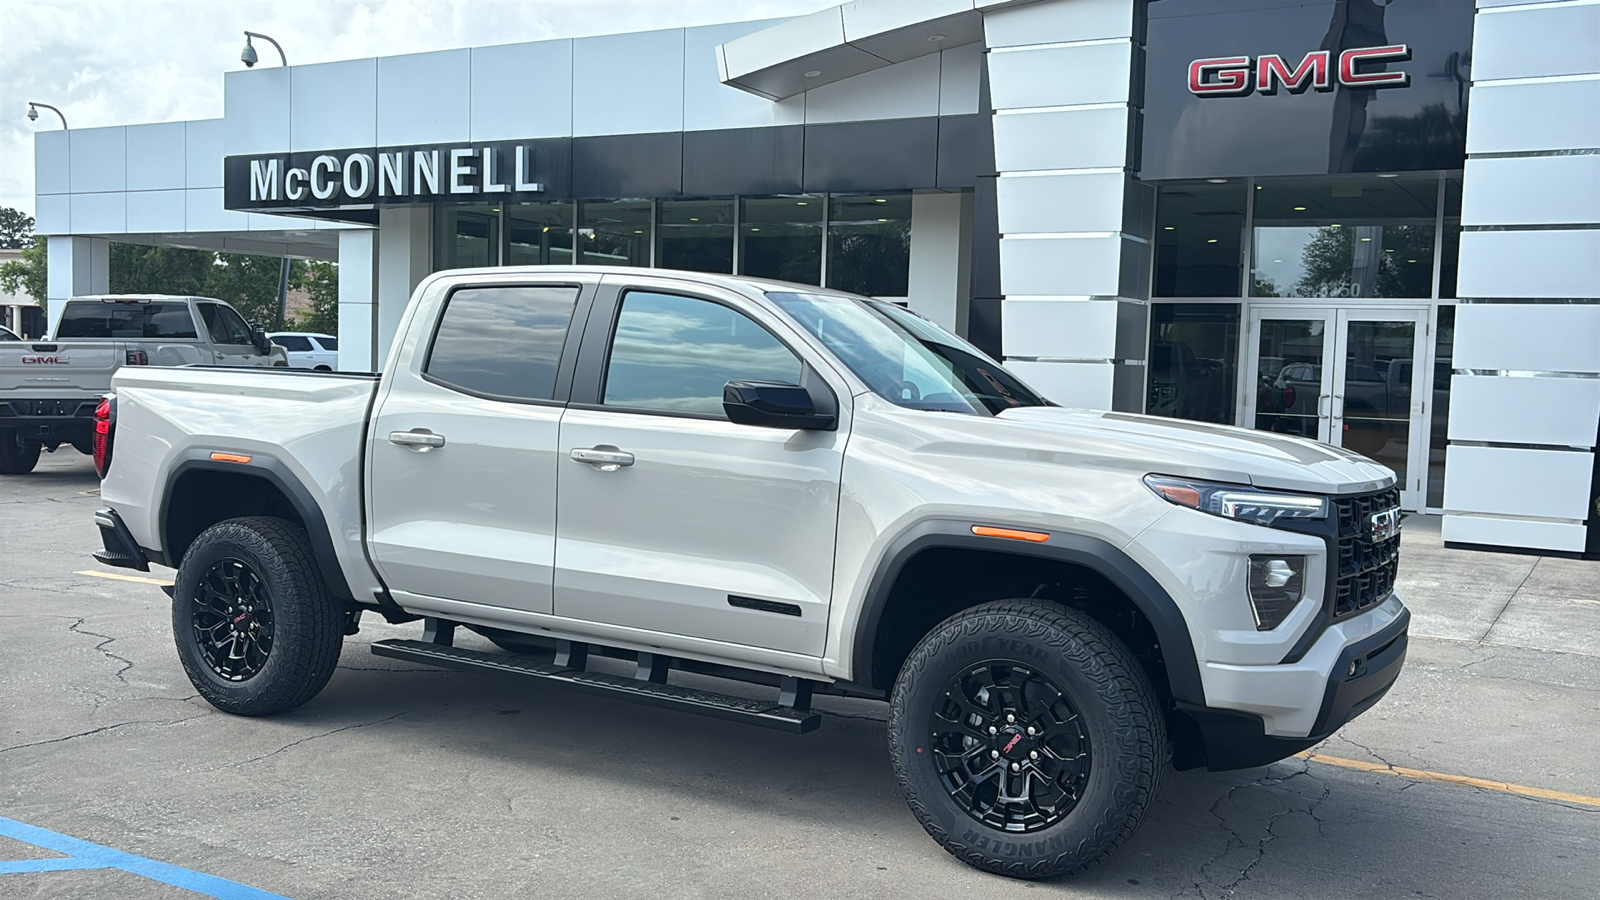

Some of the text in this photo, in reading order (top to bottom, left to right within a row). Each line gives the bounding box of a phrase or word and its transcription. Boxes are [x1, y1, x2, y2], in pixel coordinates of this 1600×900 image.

[1187, 43, 1411, 97] GMC
[250, 146, 543, 201] McCONNELL
[21, 355, 70, 365] GMC
[1002, 733, 1022, 754] GMC
